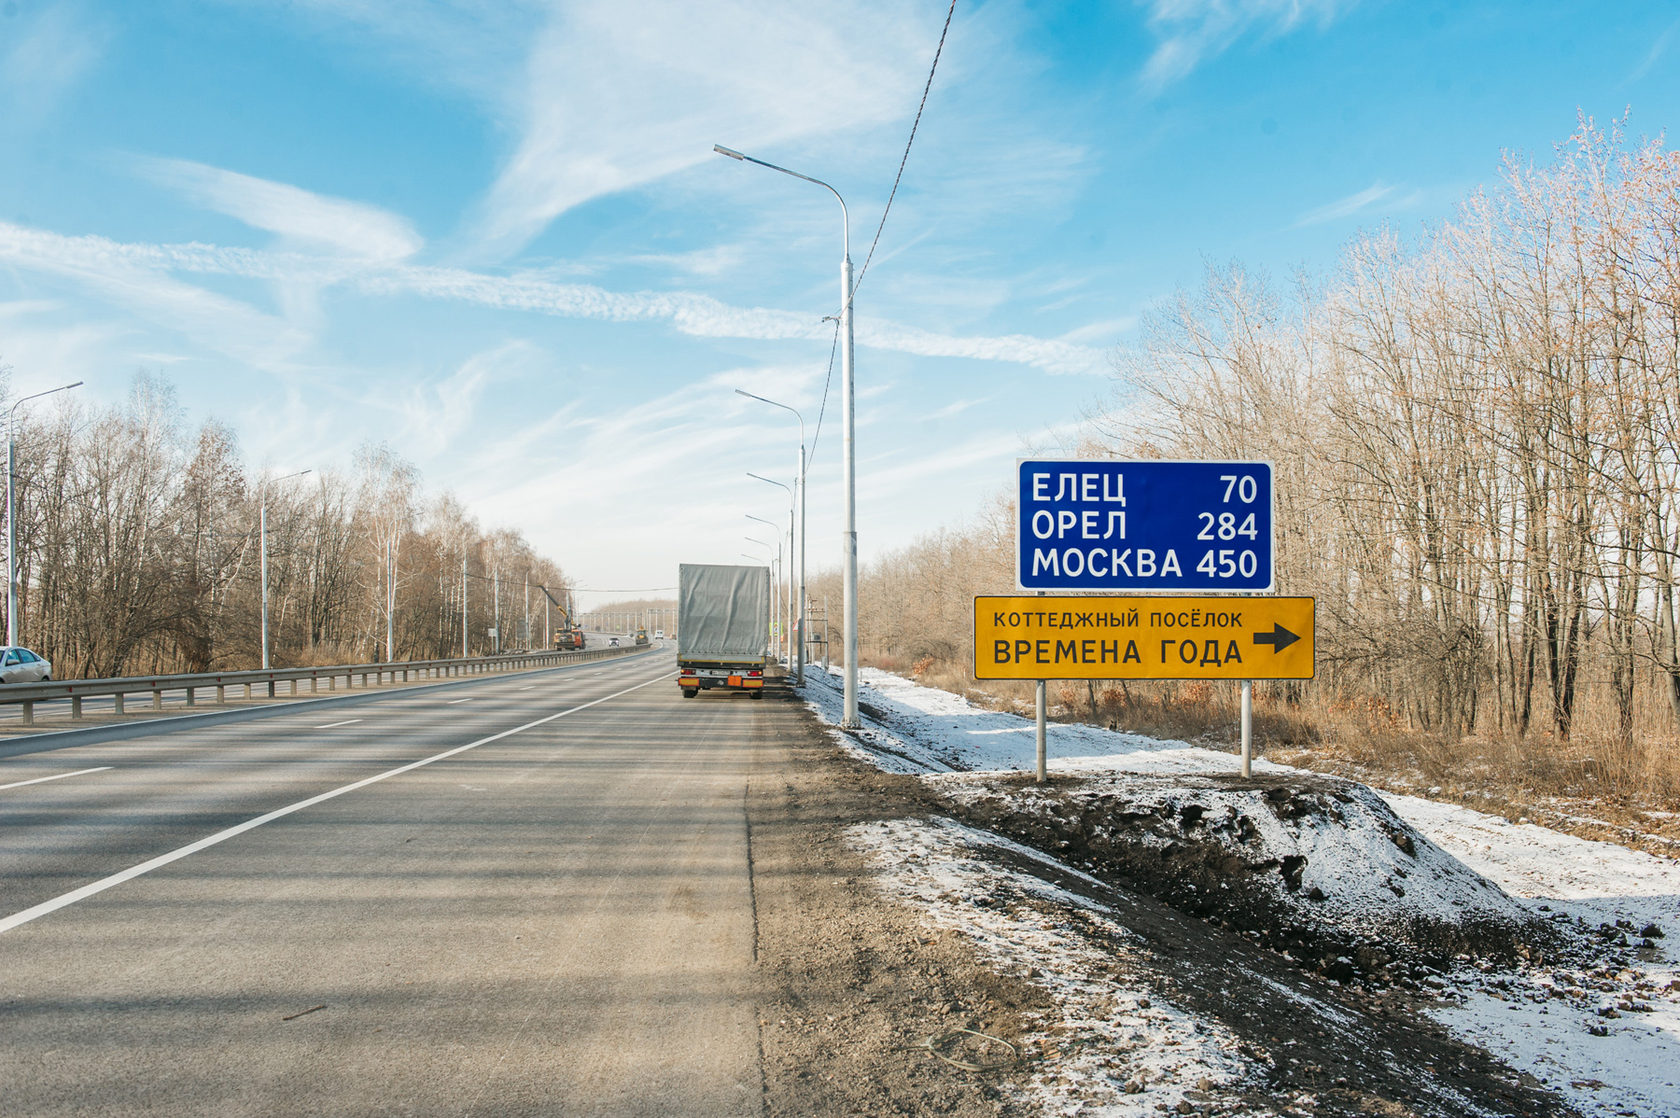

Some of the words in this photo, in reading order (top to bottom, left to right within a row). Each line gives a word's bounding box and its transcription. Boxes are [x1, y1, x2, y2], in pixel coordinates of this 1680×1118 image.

[1032, 473, 1126, 507] ЕЛЕЦ
[1220, 475, 1257, 504] 70
[1032, 510, 1126, 540] ОРЕЛ
[1197, 512, 1258, 541] 284
[1032, 548, 1183, 577] МОСКВА
[1196, 549, 1258, 578] 450
[994, 608, 1139, 629] КОТТЕДЖНЫЙ
[1150, 608, 1242, 628] ПОСЁЛОК
[994, 639, 1142, 664] ВРЕМЕНА
[1160, 639, 1243, 668] ГОДА
